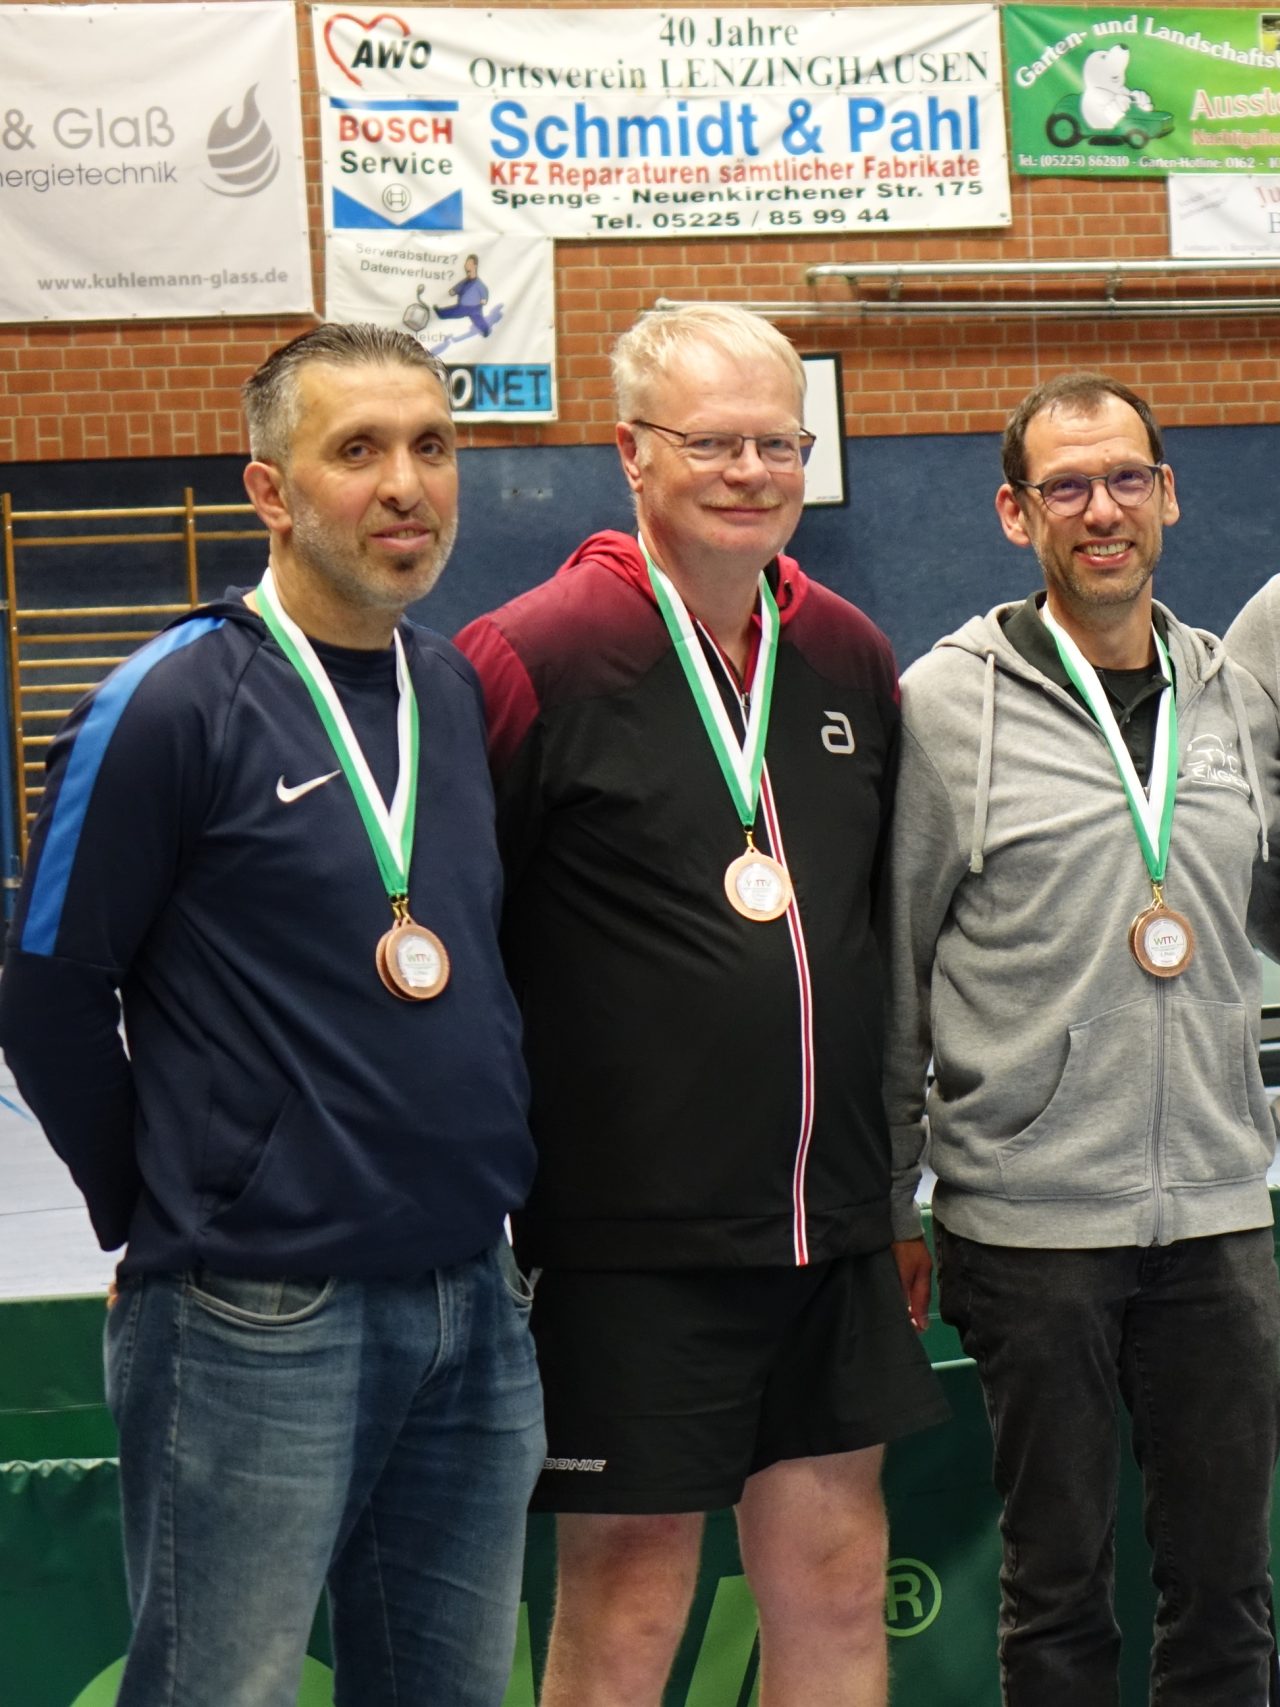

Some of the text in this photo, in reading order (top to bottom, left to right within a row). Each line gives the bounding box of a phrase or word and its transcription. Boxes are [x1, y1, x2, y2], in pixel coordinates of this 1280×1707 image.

[659, 16, 799, 47] 40 Jahre
[351, 39, 432, 70] AWO
[1015, 31, 1088, 88] Garten-
[1091, 14, 1139, 37] und
[469, 51, 988, 89] Ortsverein LENZINGHAUSEN
[2, 105, 176, 151] & Glaß
[338, 114, 453, 144] BOSCH
[490, 95, 981, 160] Schmidt & Pahl
[340, 150, 453, 175] Service
[489, 155, 980, 192] KFZ Reparaturen sämtlicher Fabrikate
[491, 188, 601, 208] Spenge
[632, 185, 865, 205] Neuenkirchener
[877, 183, 923, 199] Str.
[936, 181, 984, 197] 175
[592, 213, 642, 229] Tel.
[653, 212, 741, 229] 05225
[768, 210, 802, 226] 85
[813, 208, 847, 225] 99
[857, 207, 890, 223] 44
[356, 242, 459, 265] Serverabsturz?
[37, 267, 289, 291] www.kuhlemann-glass.de
[360, 259, 456, 281] Datenverlust?
[1153, 934, 1179, 946] WTTV
[543, 1457, 607, 1473] DONIC
